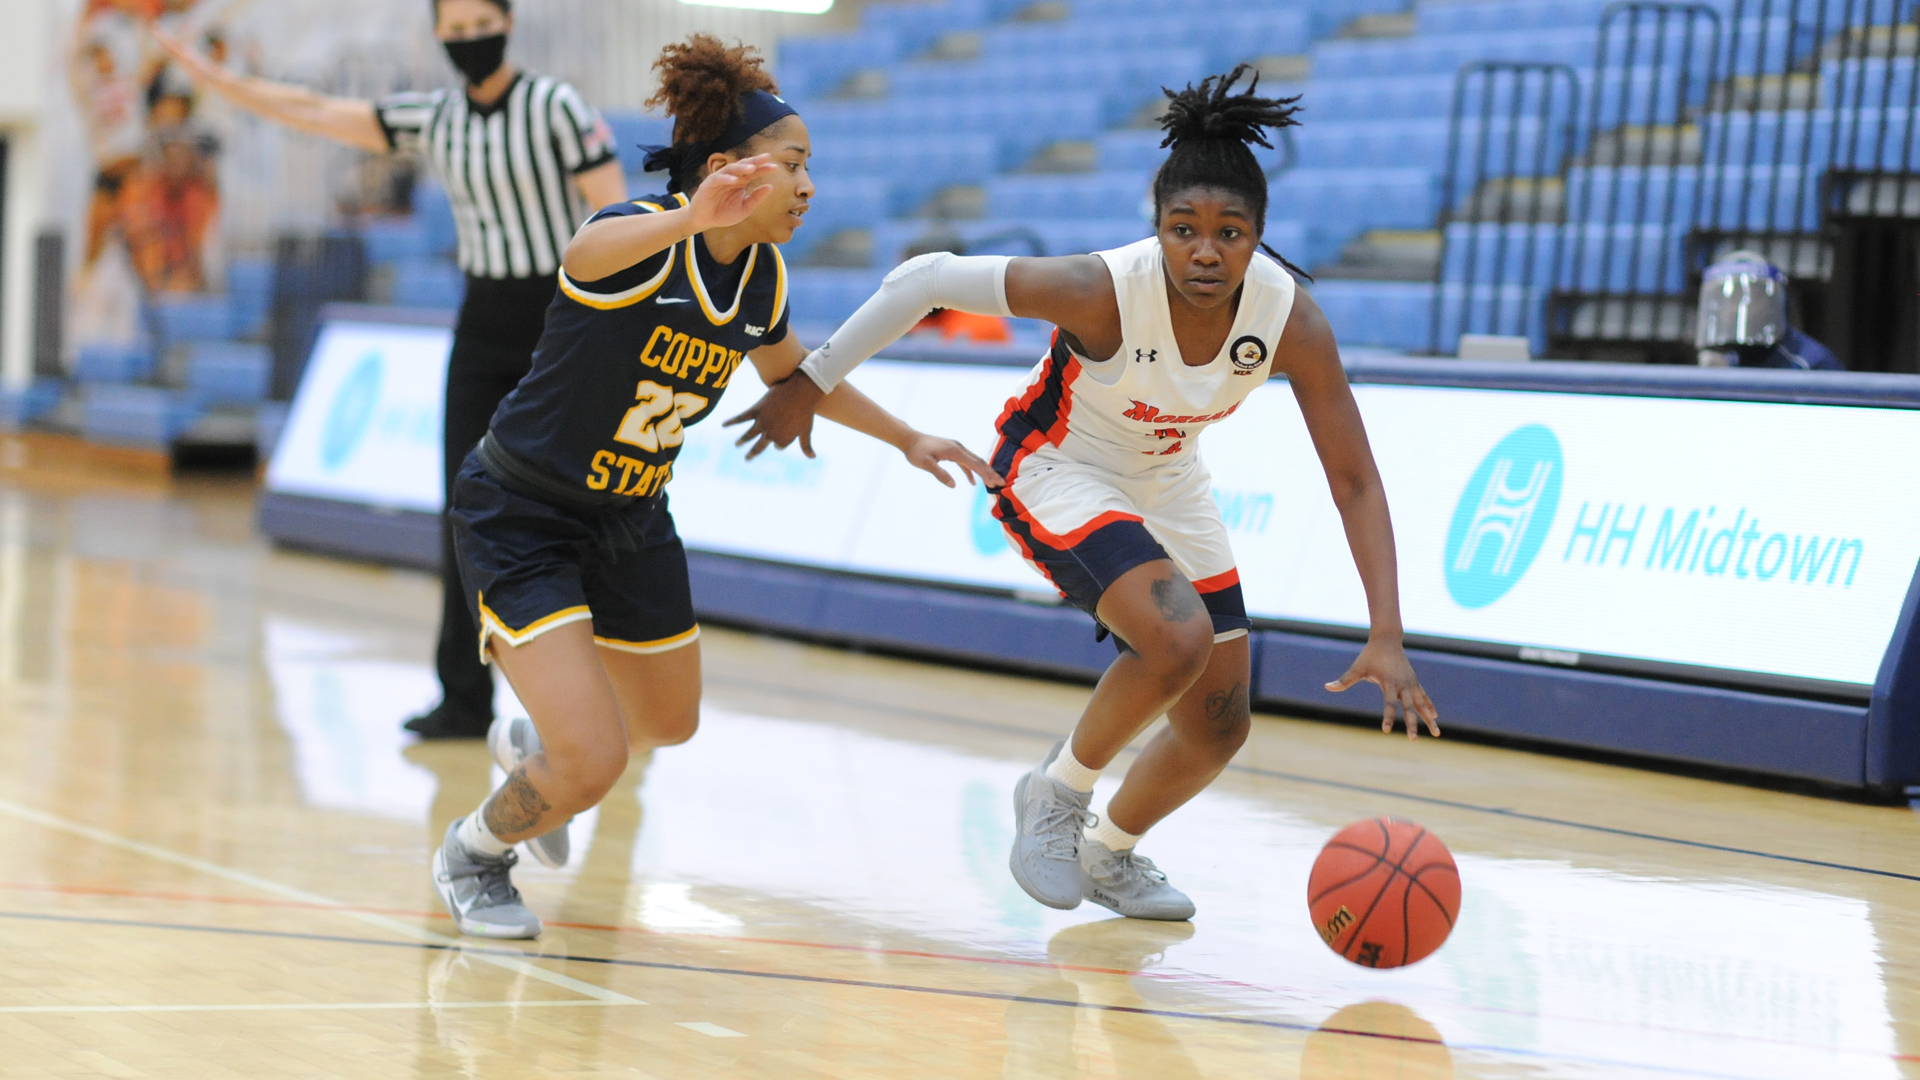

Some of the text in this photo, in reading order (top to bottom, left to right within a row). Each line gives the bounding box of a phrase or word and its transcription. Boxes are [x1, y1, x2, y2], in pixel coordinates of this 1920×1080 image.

[586, 450, 673, 498] STAT
[1563, 501, 1864, 589] HH Midtown
